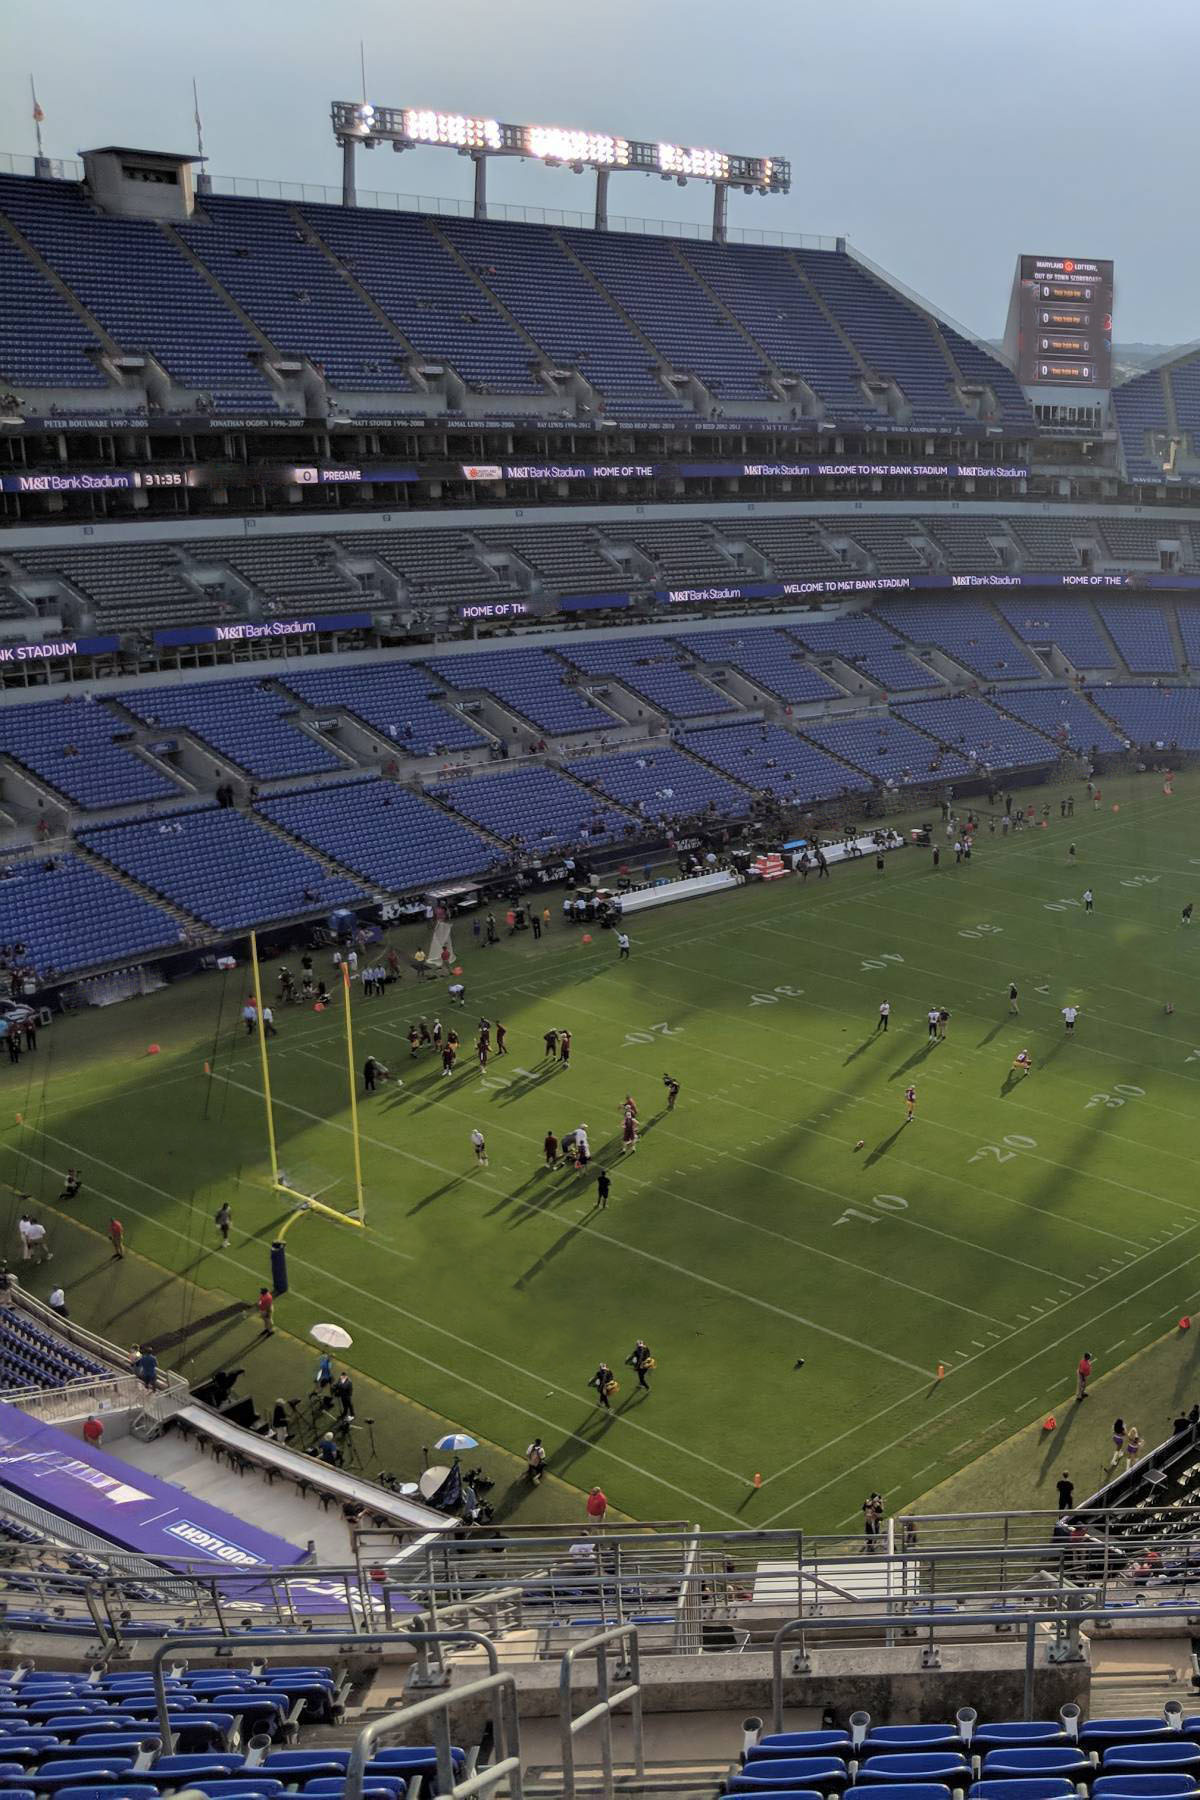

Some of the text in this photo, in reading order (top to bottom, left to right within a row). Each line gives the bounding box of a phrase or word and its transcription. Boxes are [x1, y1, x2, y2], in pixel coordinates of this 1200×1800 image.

[323, 471, 361, 480] PREGAME
[507, 467, 530, 478] M&T
[530, 467, 551, 478] Bank
[551, 467, 585, 478] Stadium
[593, 467, 653, 476] HOME OF THE
[743, 465, 809, 476] M&T Bank Stadium
[819, 465, 948, 475] WELCOME TO M&T BANK STADIUM
[958, 466, 1027, 477] M&T Bank Stadium
[20, 475, 129, 491] M&T Bank Stadium
[145, 473, 182, 485] 31:35
[784, 578, 910, 594] WELCOME TO M&T BANK STADIUM
[952, 576, 1021, 586] M&T Bank Stadium
[1062, 576, 1121, 585] HOME OF THE
[669, 589, 741, 603] M&T Bank Stadium
[463, 603, 528, 617] HOME OF TH
[216, 621, 316, 641] M&T Bank Stadium
[17, 642, 77, 660] STADIUM
[750, 984, 805, 1005] 30
[624, 1021, 685, 1045] 20
[1092, 1083, 1147, 1109] 30
[976, 1134, 1039, 1164] 20
[841, 1193, 910, 1225] 10
